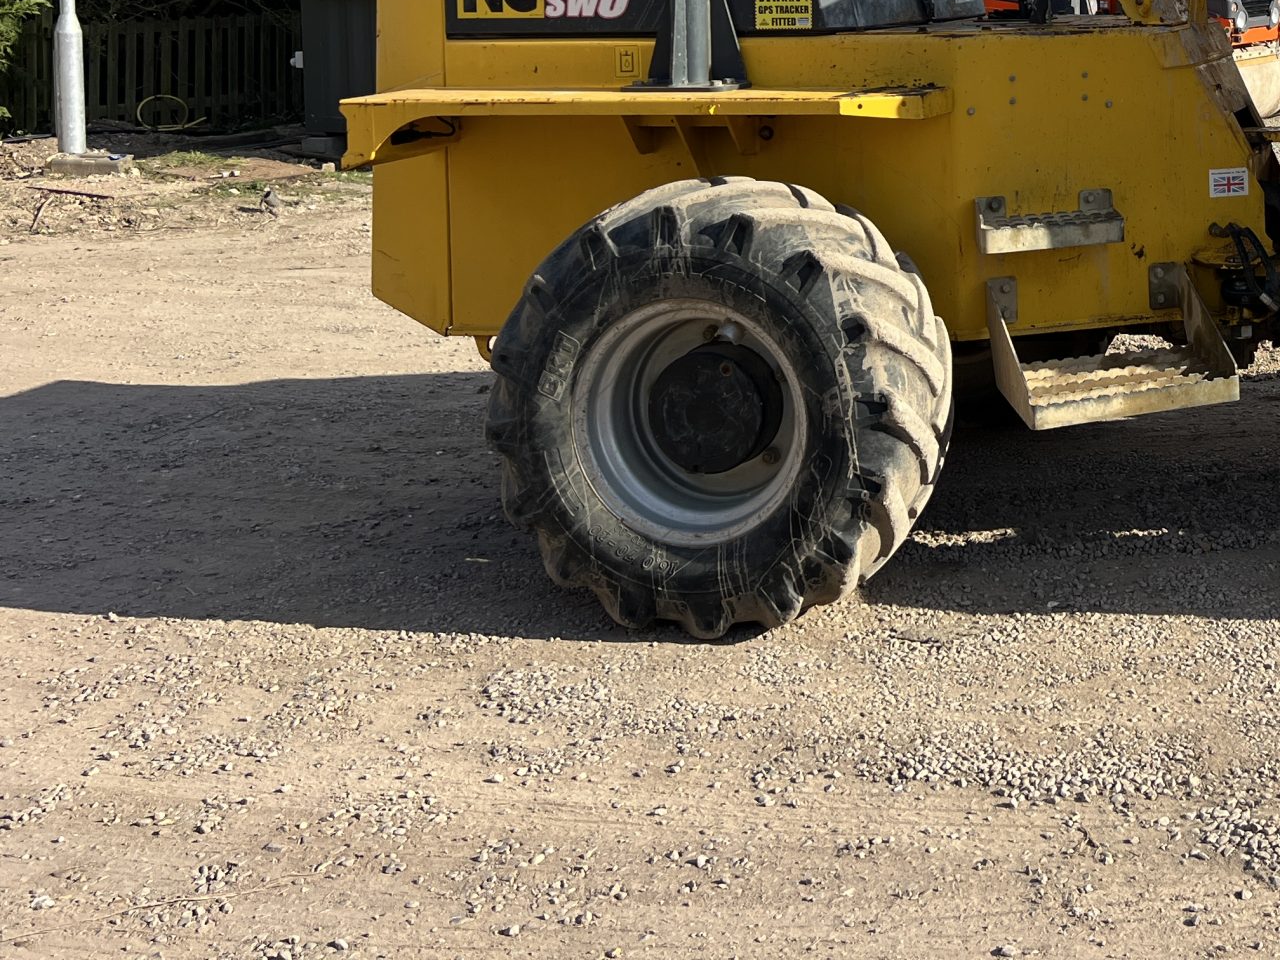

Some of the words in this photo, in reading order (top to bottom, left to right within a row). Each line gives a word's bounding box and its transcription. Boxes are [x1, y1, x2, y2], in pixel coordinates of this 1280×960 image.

[758, 5, 773, 14] GPS
[775, 5, 809, 14] TRACKER
[771, 17, 797, 26] FITTED
